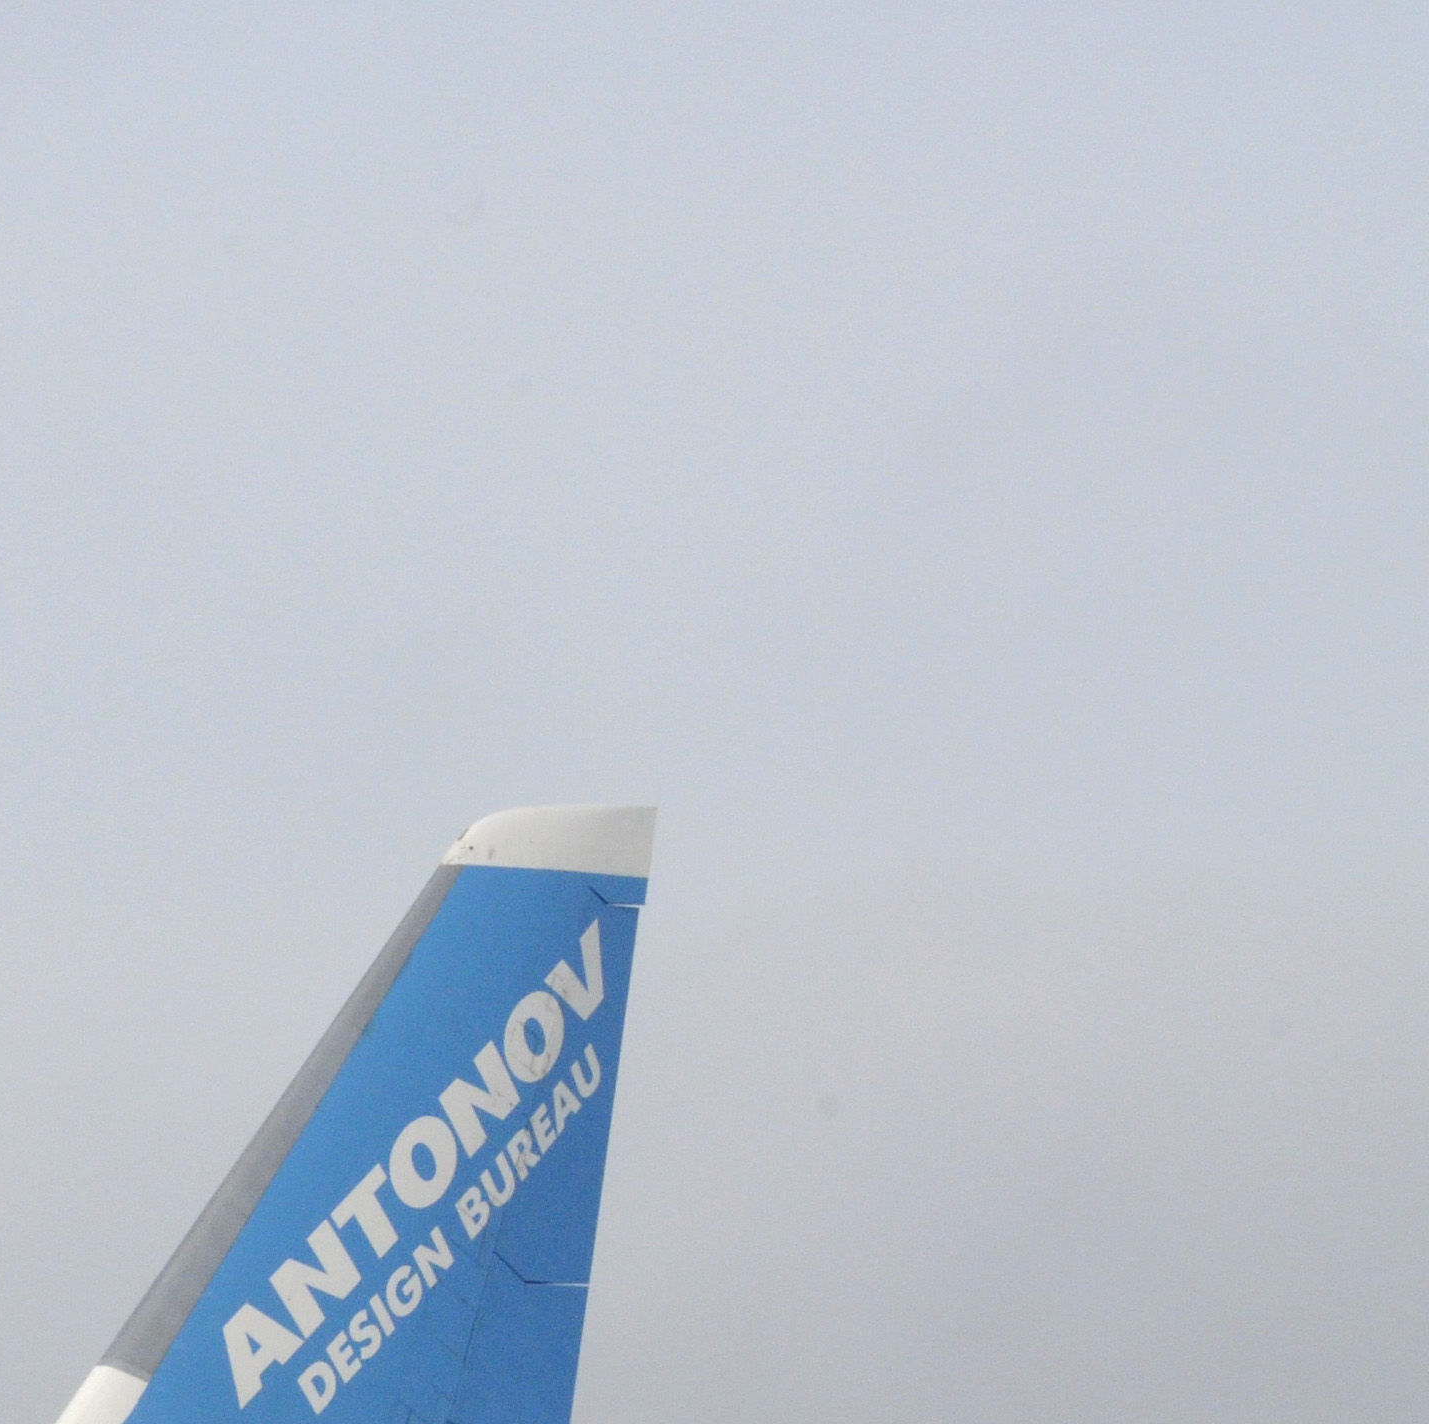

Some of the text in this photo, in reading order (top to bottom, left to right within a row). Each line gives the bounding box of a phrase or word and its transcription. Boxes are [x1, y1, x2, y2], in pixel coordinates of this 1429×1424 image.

[222, 918, 605, 1410] ANTONOV
[296, 1043, 603, 1415] DESIGN BUREAU
